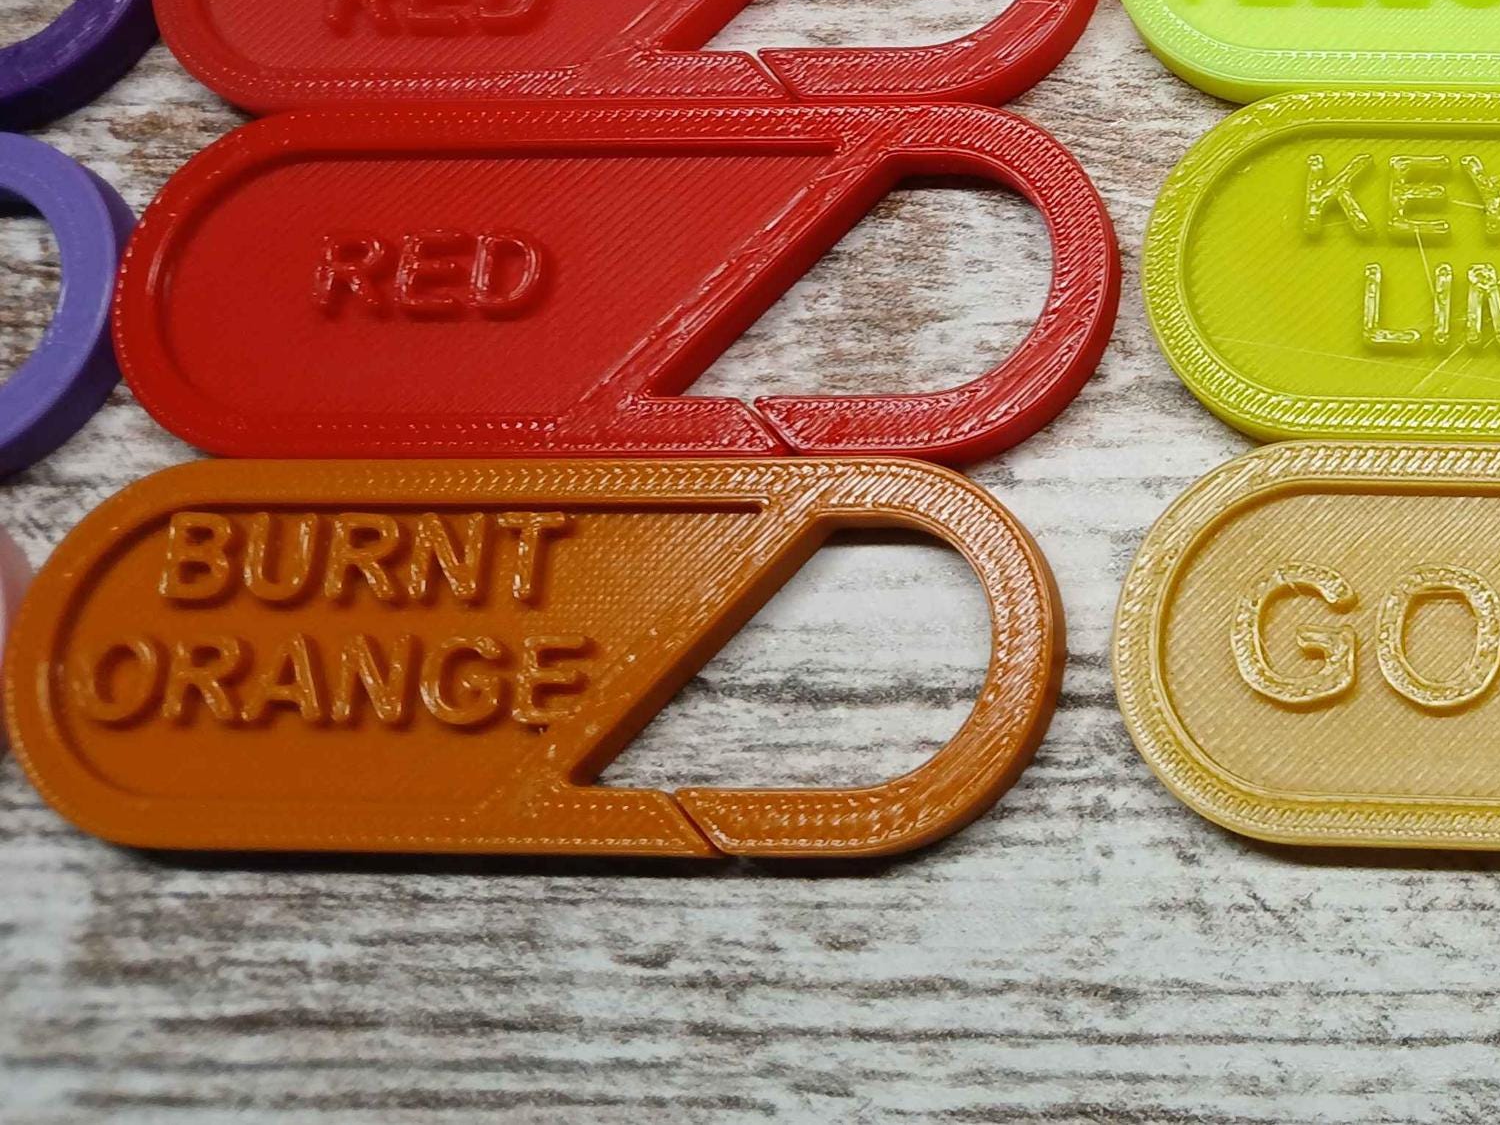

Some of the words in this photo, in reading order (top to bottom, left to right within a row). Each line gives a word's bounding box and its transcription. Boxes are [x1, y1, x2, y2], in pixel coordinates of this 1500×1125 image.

[311, 226, 552, 322] RED
[155, 510, 575, 608] BURNT
[82, 631, 598, 732] ORANGE
